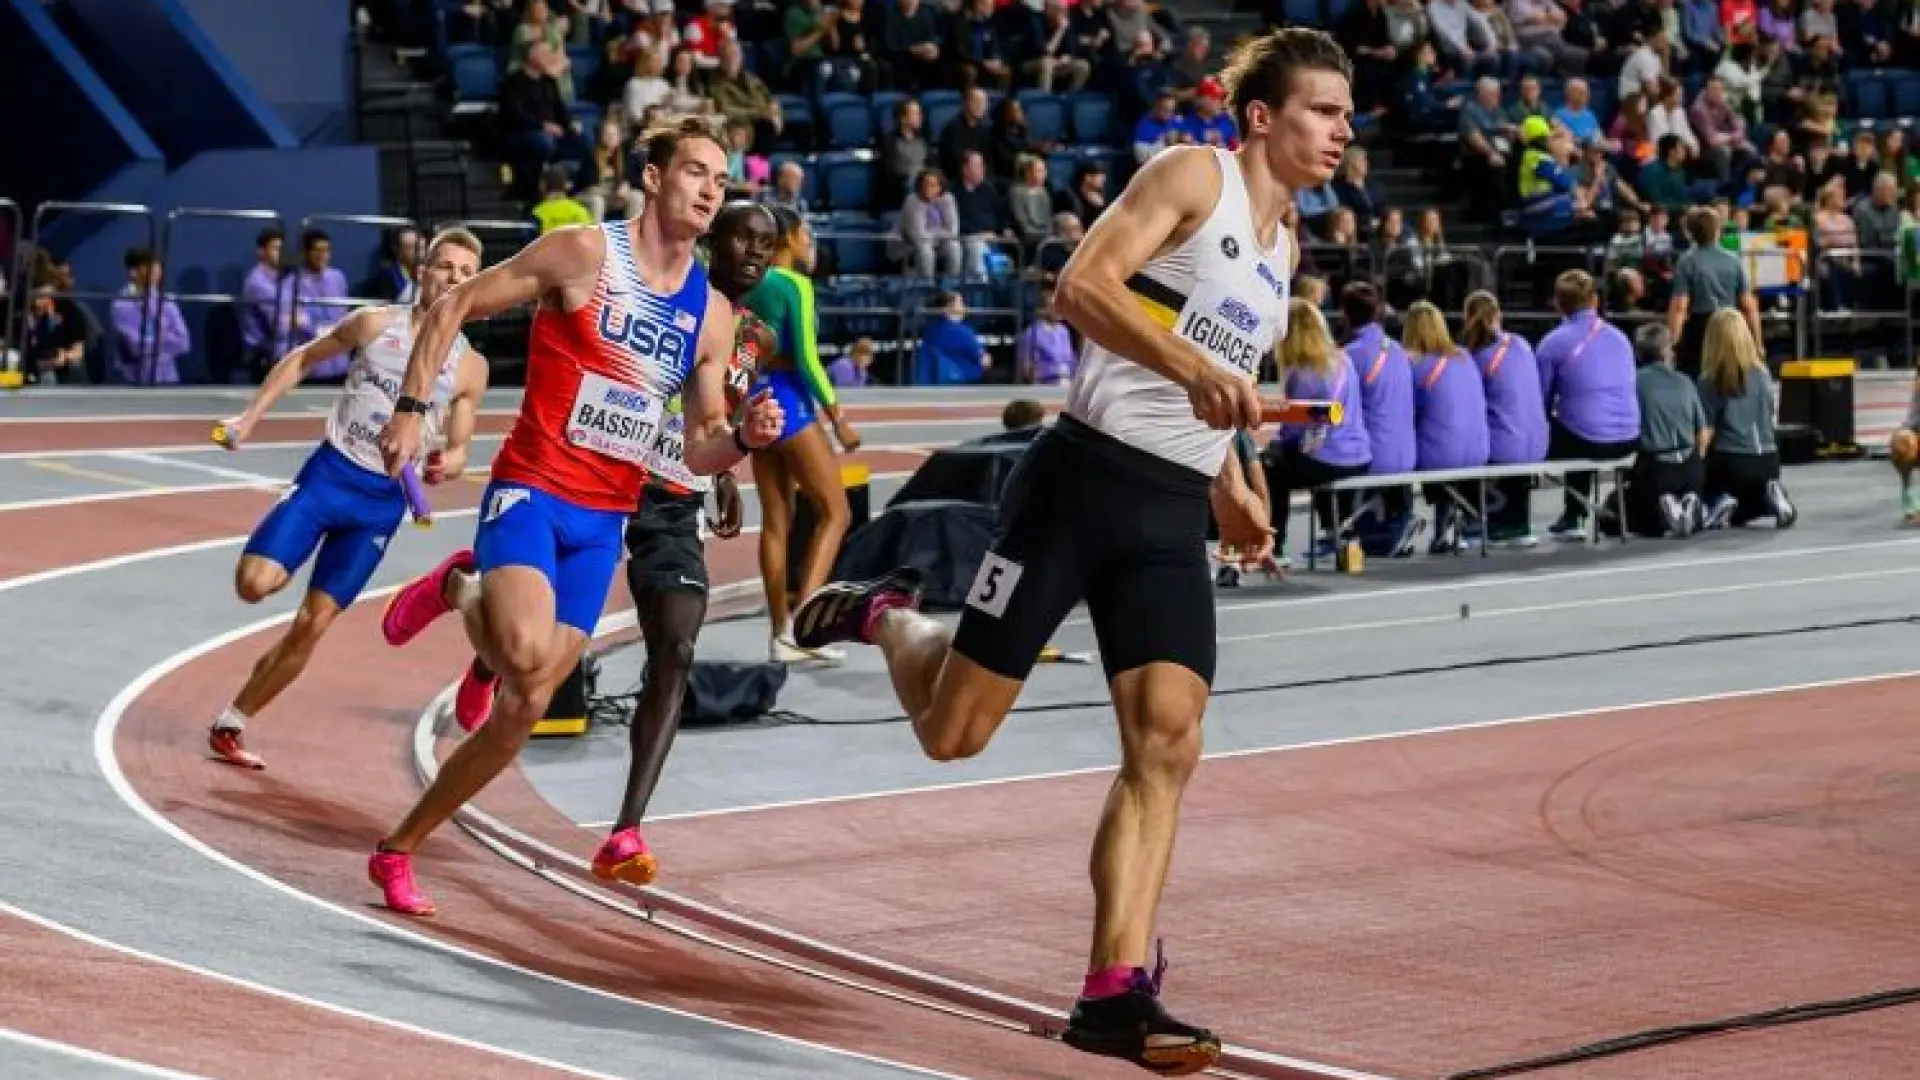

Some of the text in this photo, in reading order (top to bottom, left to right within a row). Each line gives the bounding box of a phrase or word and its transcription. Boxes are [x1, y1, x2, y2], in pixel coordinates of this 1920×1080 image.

[601, 304, 682, 369] USA
[576, 403, 654, 443] BASSITT
[979, 565, 1004, 603] 5
